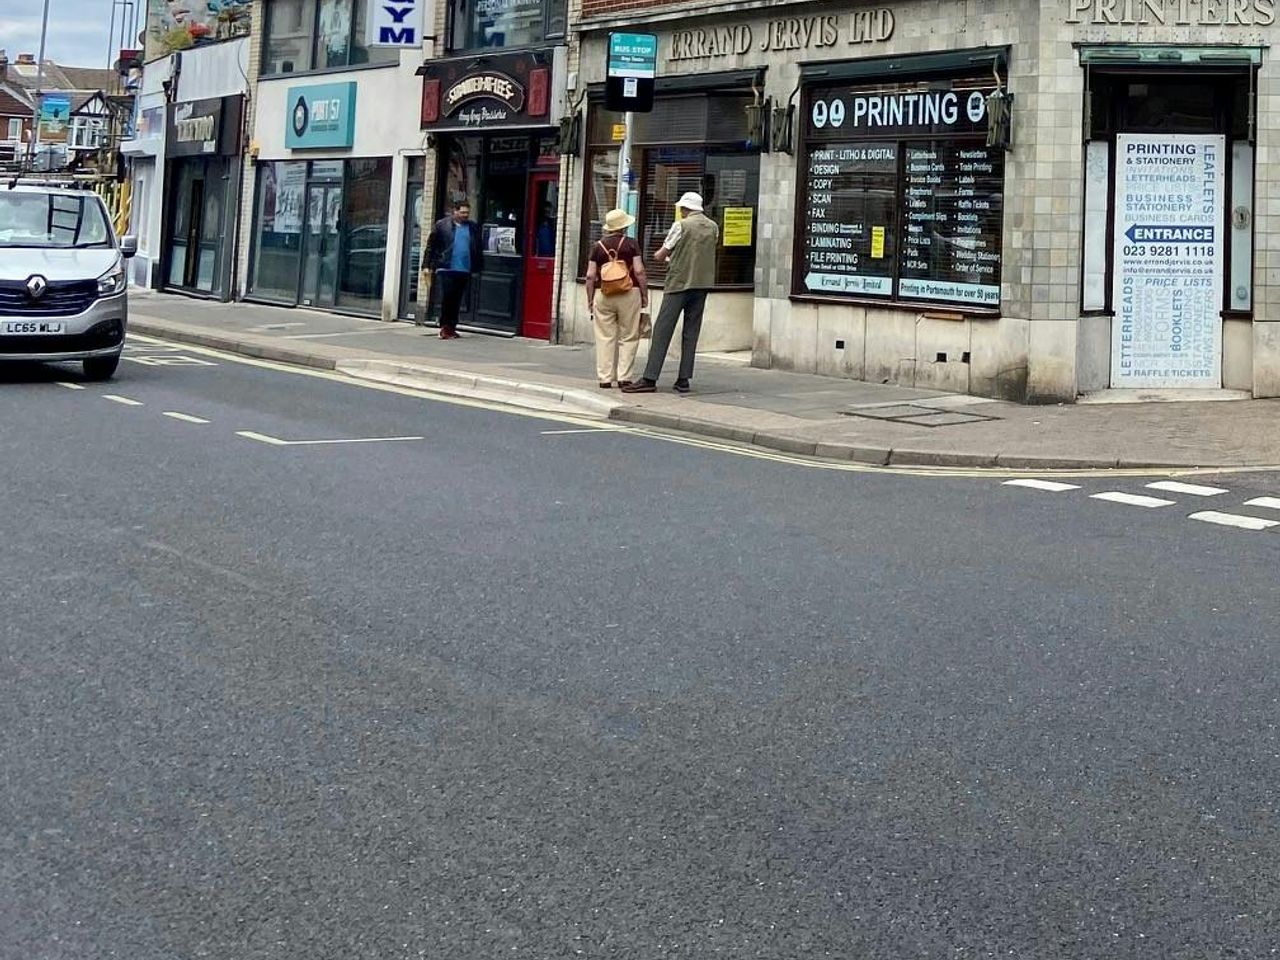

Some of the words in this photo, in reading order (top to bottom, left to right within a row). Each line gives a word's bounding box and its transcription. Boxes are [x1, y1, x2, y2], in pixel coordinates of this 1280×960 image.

[669, 24, 752, 61] ERRAND
[760, 14, 839, 52] JERVIS
[848, 8, 896, 45] LTD
[854, 92, 958, 127] PRINTING
[814, 150, 835, 160] PRINT
[839, 149, 860, 160] LITHO
[867, 148, 895, 160] DIGITAL
[1126, 143, 1196, 155] PRINTING
[1135, 157, 1196, 165] STATIONERY
[814, 165, 840, 175] DESIGN
[813, 179, 832, 189] COPY
[1126, 174, 1196, 183] LETTERHEADS
[1203, 144, 1215, 214] LEAFLETS
[812, 194, 832, 204] SCAN
[1126, 194, 1192, 202] BUSINESS
[812, 208, 825, 218] FAX
[1126, 203, 1193, 212] STATIONERY
[1125, 214, 1176, 222] BUSINESS
[1179, 214, 1214, 222] CARDS
[811, 223, 840, 234] BINDING
[1135, 228, 1213, 240] ENTRANCE
[810, 237, 852, 249] LAMINATING
[1123, 245, 1146, 257] 023
[1150, 245, 1179, 257] 9281
[1185, 246, 1214, 257] 1118
[810, 252, 825, 263] FILE
[825, 252, 858, 264] PRINTING
[1145, 278, 1178, 287] PRICE
[1183, 278, 1213, 287] LISTS
[901, 282, 920, 296] Printing
[926, 285, 955, 296] Portsmouth
[964, 289, 976, 298] over
[1154, 287, 1171, 342] FORMS
[1172, 289, 1183, 352] BOOKLETS
[1183, 288, 1192, 350] WEDDING
[7, 323, 37, 333] LC65
[1121, 276, 1134, 377] LETTERHEADS
[1193, 289, 1202, 368] STATIONERY
